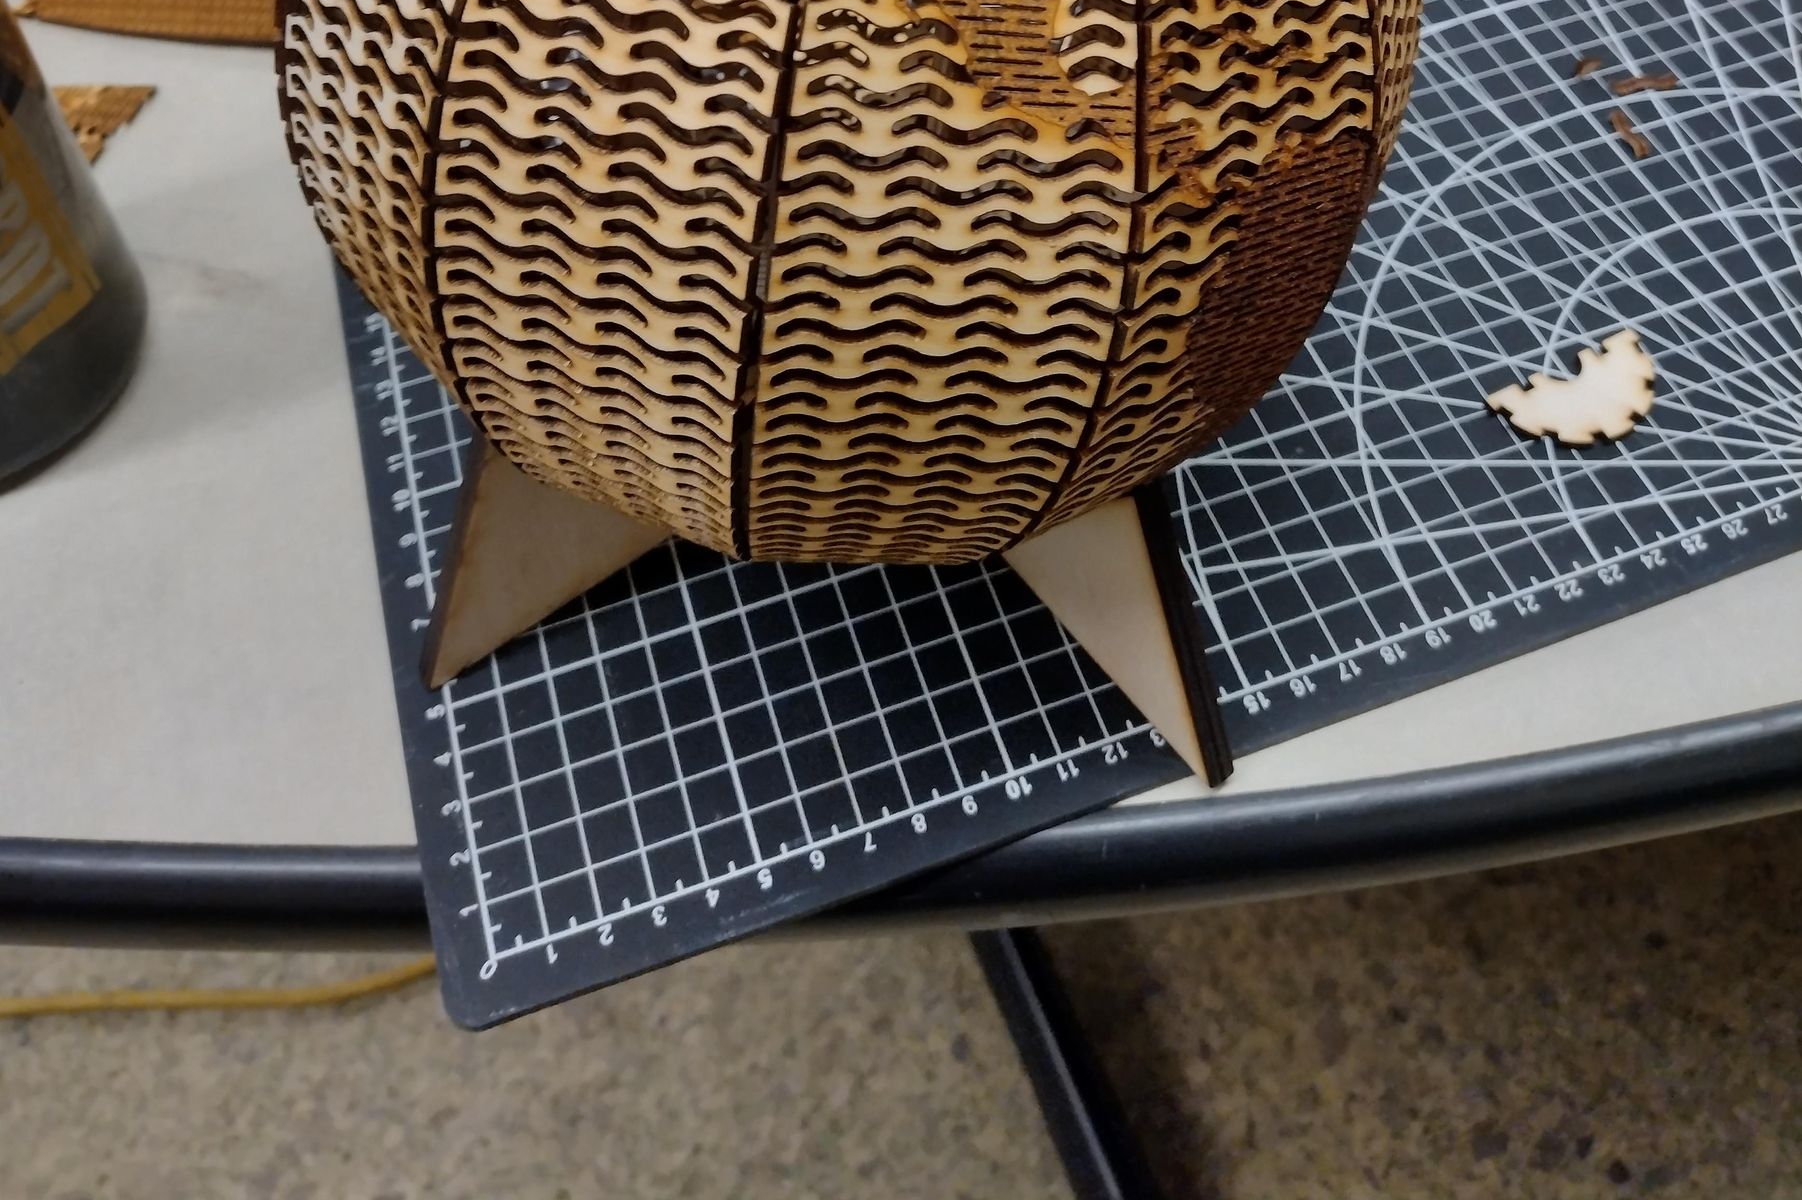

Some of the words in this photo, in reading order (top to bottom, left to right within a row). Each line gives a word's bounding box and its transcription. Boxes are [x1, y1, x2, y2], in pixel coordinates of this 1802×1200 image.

[391, 488, 411, 512] 10
[1763, 503, 1788, 526] 27
[398, 532, 418, 548] 9
[1720, 518, 1750, 540] 26
[1680, 533, 1709, 557] 25
[1639, 548, 1668, 571] 24
[1597, 563, 1627, 587] 23
[1553, 578, 1584, 602] 22
[1513, 593, 1542, 617] 21
[1468, 608, 1498, 633] 20
[1424, 626, 1452, 650] 19
[1379, 642, 1408, 666] 18
[1338, 658, 1363, 683] 17
[1289, 674, 1318, 698] 16
[425, 703, 446, 720] 5
[1242, 690, 1272, 715] 15
[433, 751, 452, 767] 4
[1101, 741, 1130, 766] 12
[1055, 758, 1081, 783] 11
[1005, 775, 1033, 800] 10
[440, 799, 461, 816] 3
[961, 794, 979, 816] 9
[911, 812, 928, 834] 8
[863, 831, 878, 853] 7
[449, 848, 471, 867] 2
[809, 849, 826, 872] 6
[756, 867, 773, 891] 5
[705, 887, 720, 909] 4
[458, 903, 479, 917] 1
[651, 905, 668, 928] 3
[597, 922, 615, 947] 2
[545, 943, 559, 965] 1
[478, 959, 499, 981] 0
